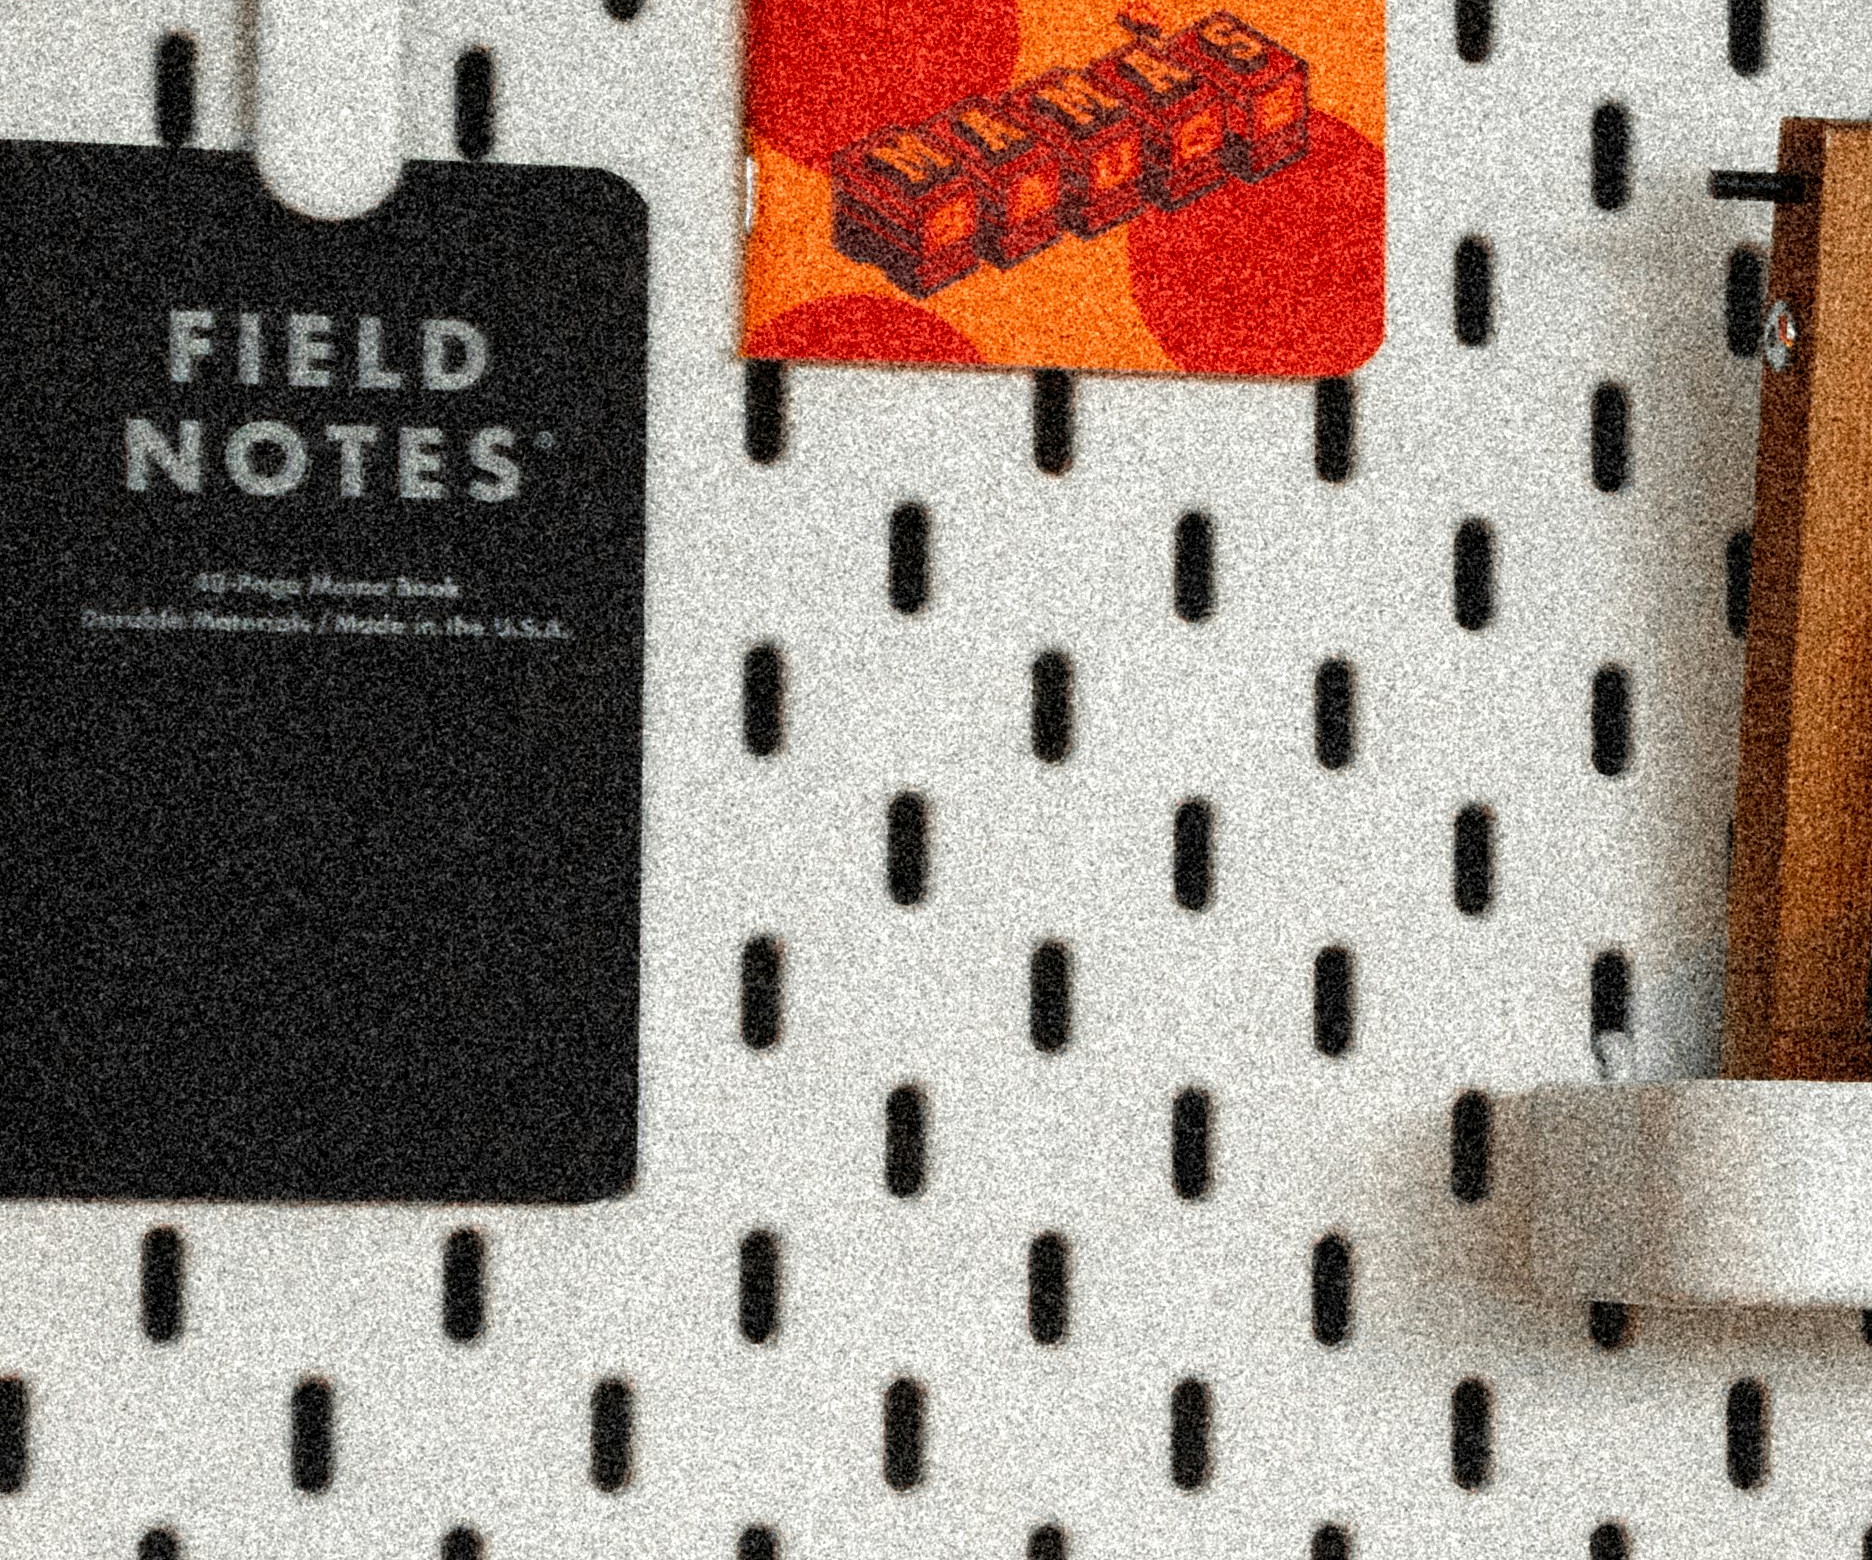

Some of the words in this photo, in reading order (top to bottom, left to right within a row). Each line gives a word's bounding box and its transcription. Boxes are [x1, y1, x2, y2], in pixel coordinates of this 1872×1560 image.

[167, 308, 490, 393] FIELD
[396, 576, 460, 598] Book
[334, 613, 407, 635] Made
